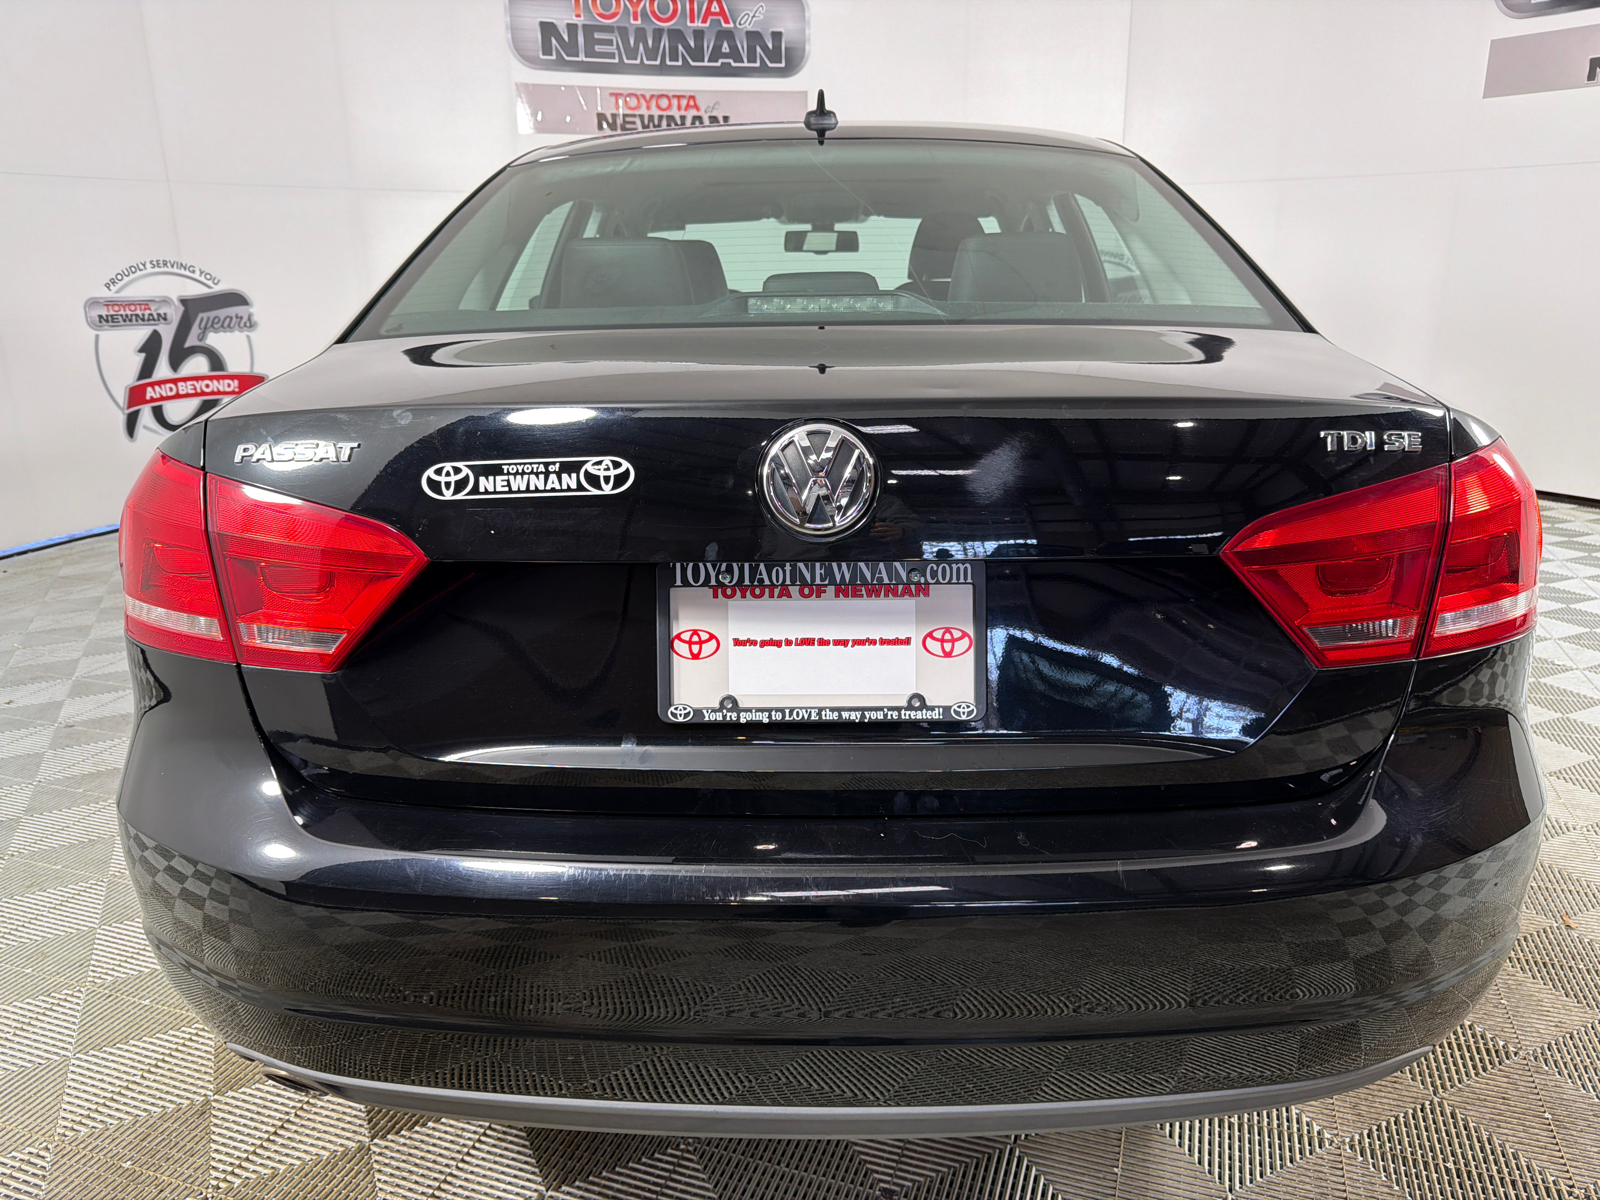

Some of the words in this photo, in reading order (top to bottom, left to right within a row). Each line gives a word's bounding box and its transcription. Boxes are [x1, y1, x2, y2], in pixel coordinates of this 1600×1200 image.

[736, 3, 765, 28] of
[538, 20, 785, 67] NEWNAN
[609, 92, 701, 112] TOYOTA
[704, 101, 720, 114] of
[104, 261, 147, 291] PROUDLY
[149, 259, 197, 274] SERVING
[198, 268, 221, 286] YOU
[97, 312, 168, 324] NEWNAN
[103, 303, 152, 313] TOYOTA
[197, 313, 252, 342] years
[145, 384, 177, 400] AND
[177, 379, 239, 395] BEYOND!
[1319, 430, 1375, 451] TDI
[1383, 430, 1422, 451] SE
[234, 441, 361, 463] PASSAT
[502, 464, 545, 473] TOYOTA
[548, 463, 560, 472] of
[479, 473, 577, 492] NEWNAN
[708, 585, 792, 599] TOYOTA
[798, 585, 827, 599] OF
[834, 584, 930, 598] NEWNAN
[732, 638, 758, 647] You're
[759, 638, 783, 648] going
[784, 638, 793, 647] to
[794, 637, 816, 647] LOVE
[816, 637, 831, 646] the
[832, 639, 850, 648] way
[851, 637, 877, 648] you're
[878, 637, 912, 646] treated!
[702, 709, 737, 720] You're
[740, 709, 769, 723] going
[771, 710, 783, 720] to
[784, 709, 819, 720] LOVE
[821, 708, 839, 720] the
[841, 711, 862, 722] way
[864, 708, 899, 722] you're
[901, 707, 943, 719] treated!
